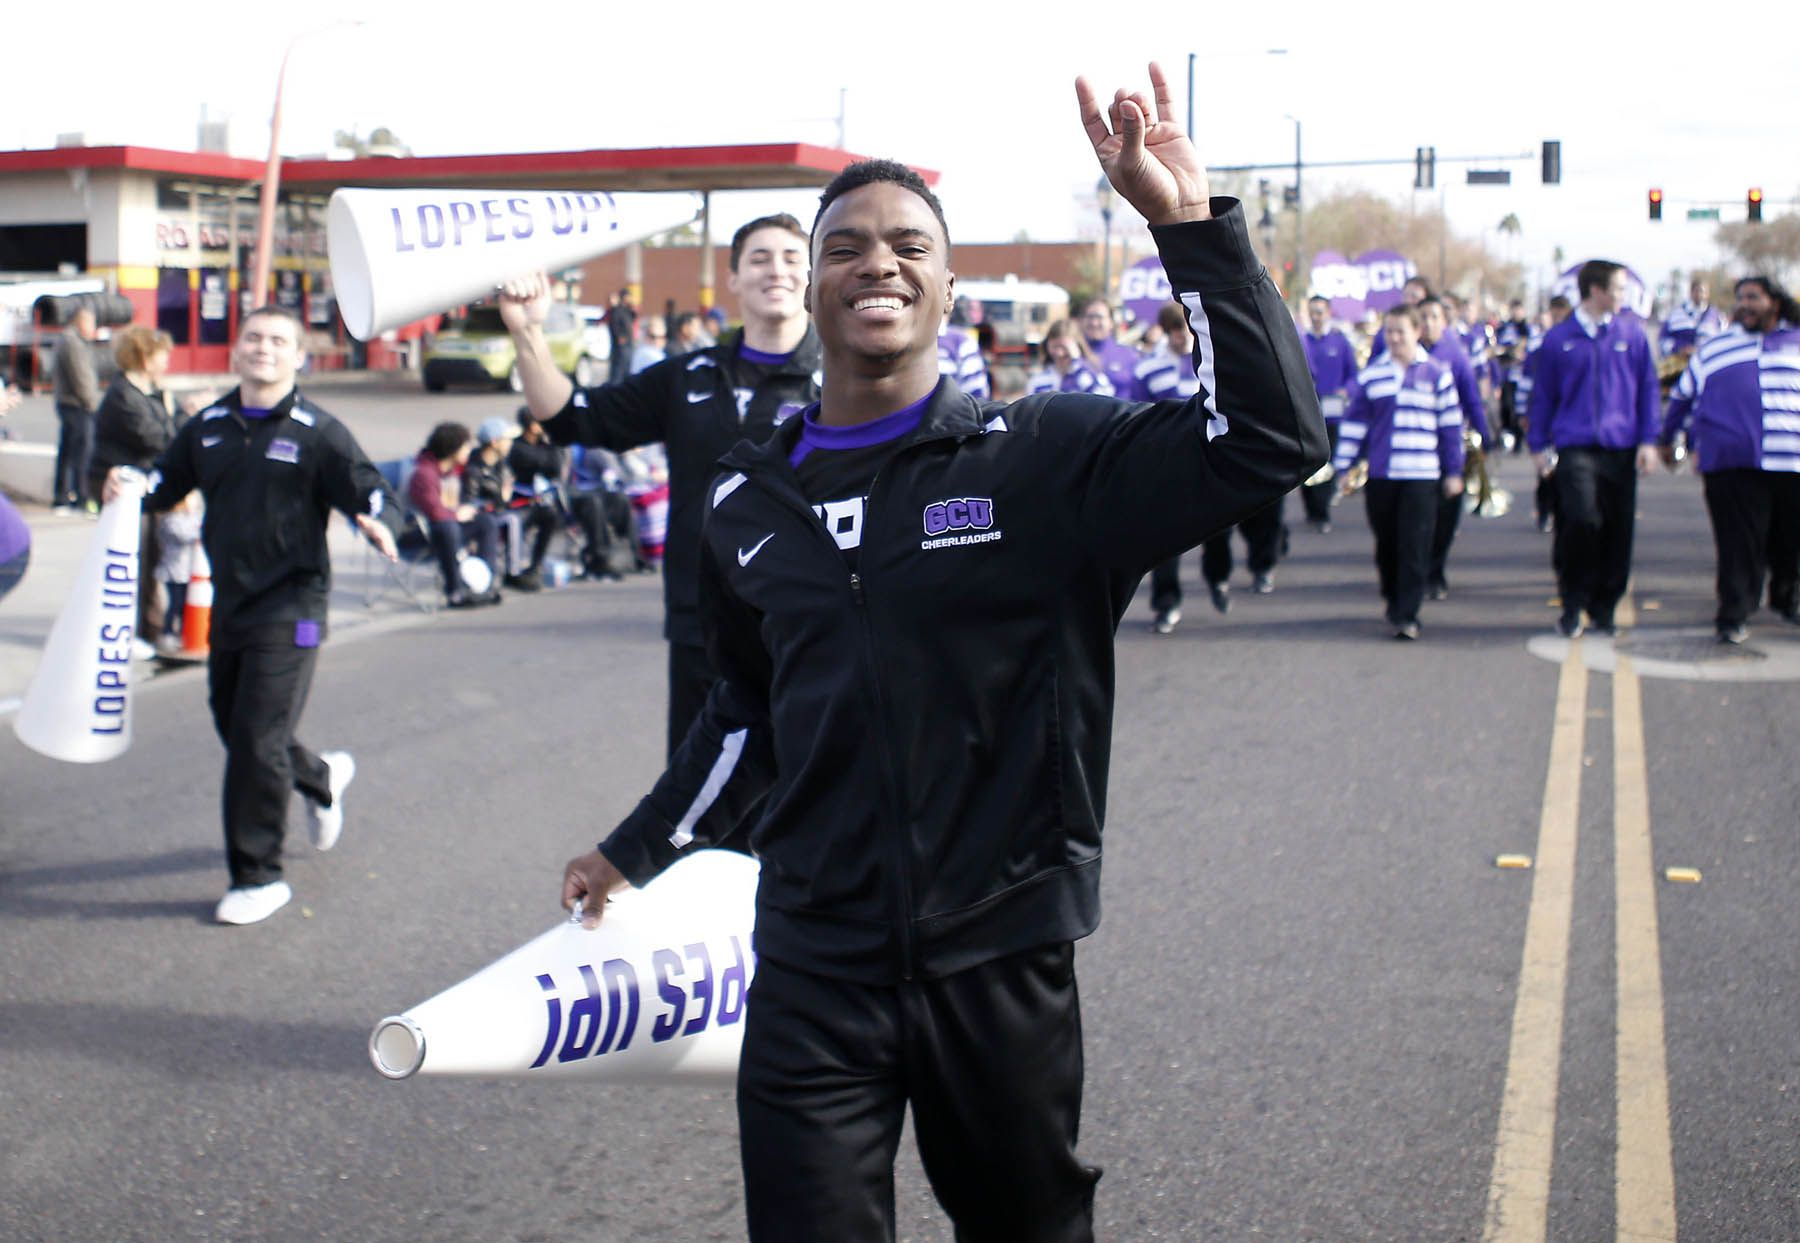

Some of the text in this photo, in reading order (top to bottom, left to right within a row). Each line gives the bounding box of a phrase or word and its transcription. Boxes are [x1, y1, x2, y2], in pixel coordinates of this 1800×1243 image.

[391, 192, 619, 253] LOPES UP!
[1121, 267, 1172, 300] GC
[921, 530, 1002, 550] CHEERLEADERS
[924, 497, 993, 536] GCU
[91, 547, 138, 735] LOPES UP!
[528, 931, 758, 1070] PES UP!
